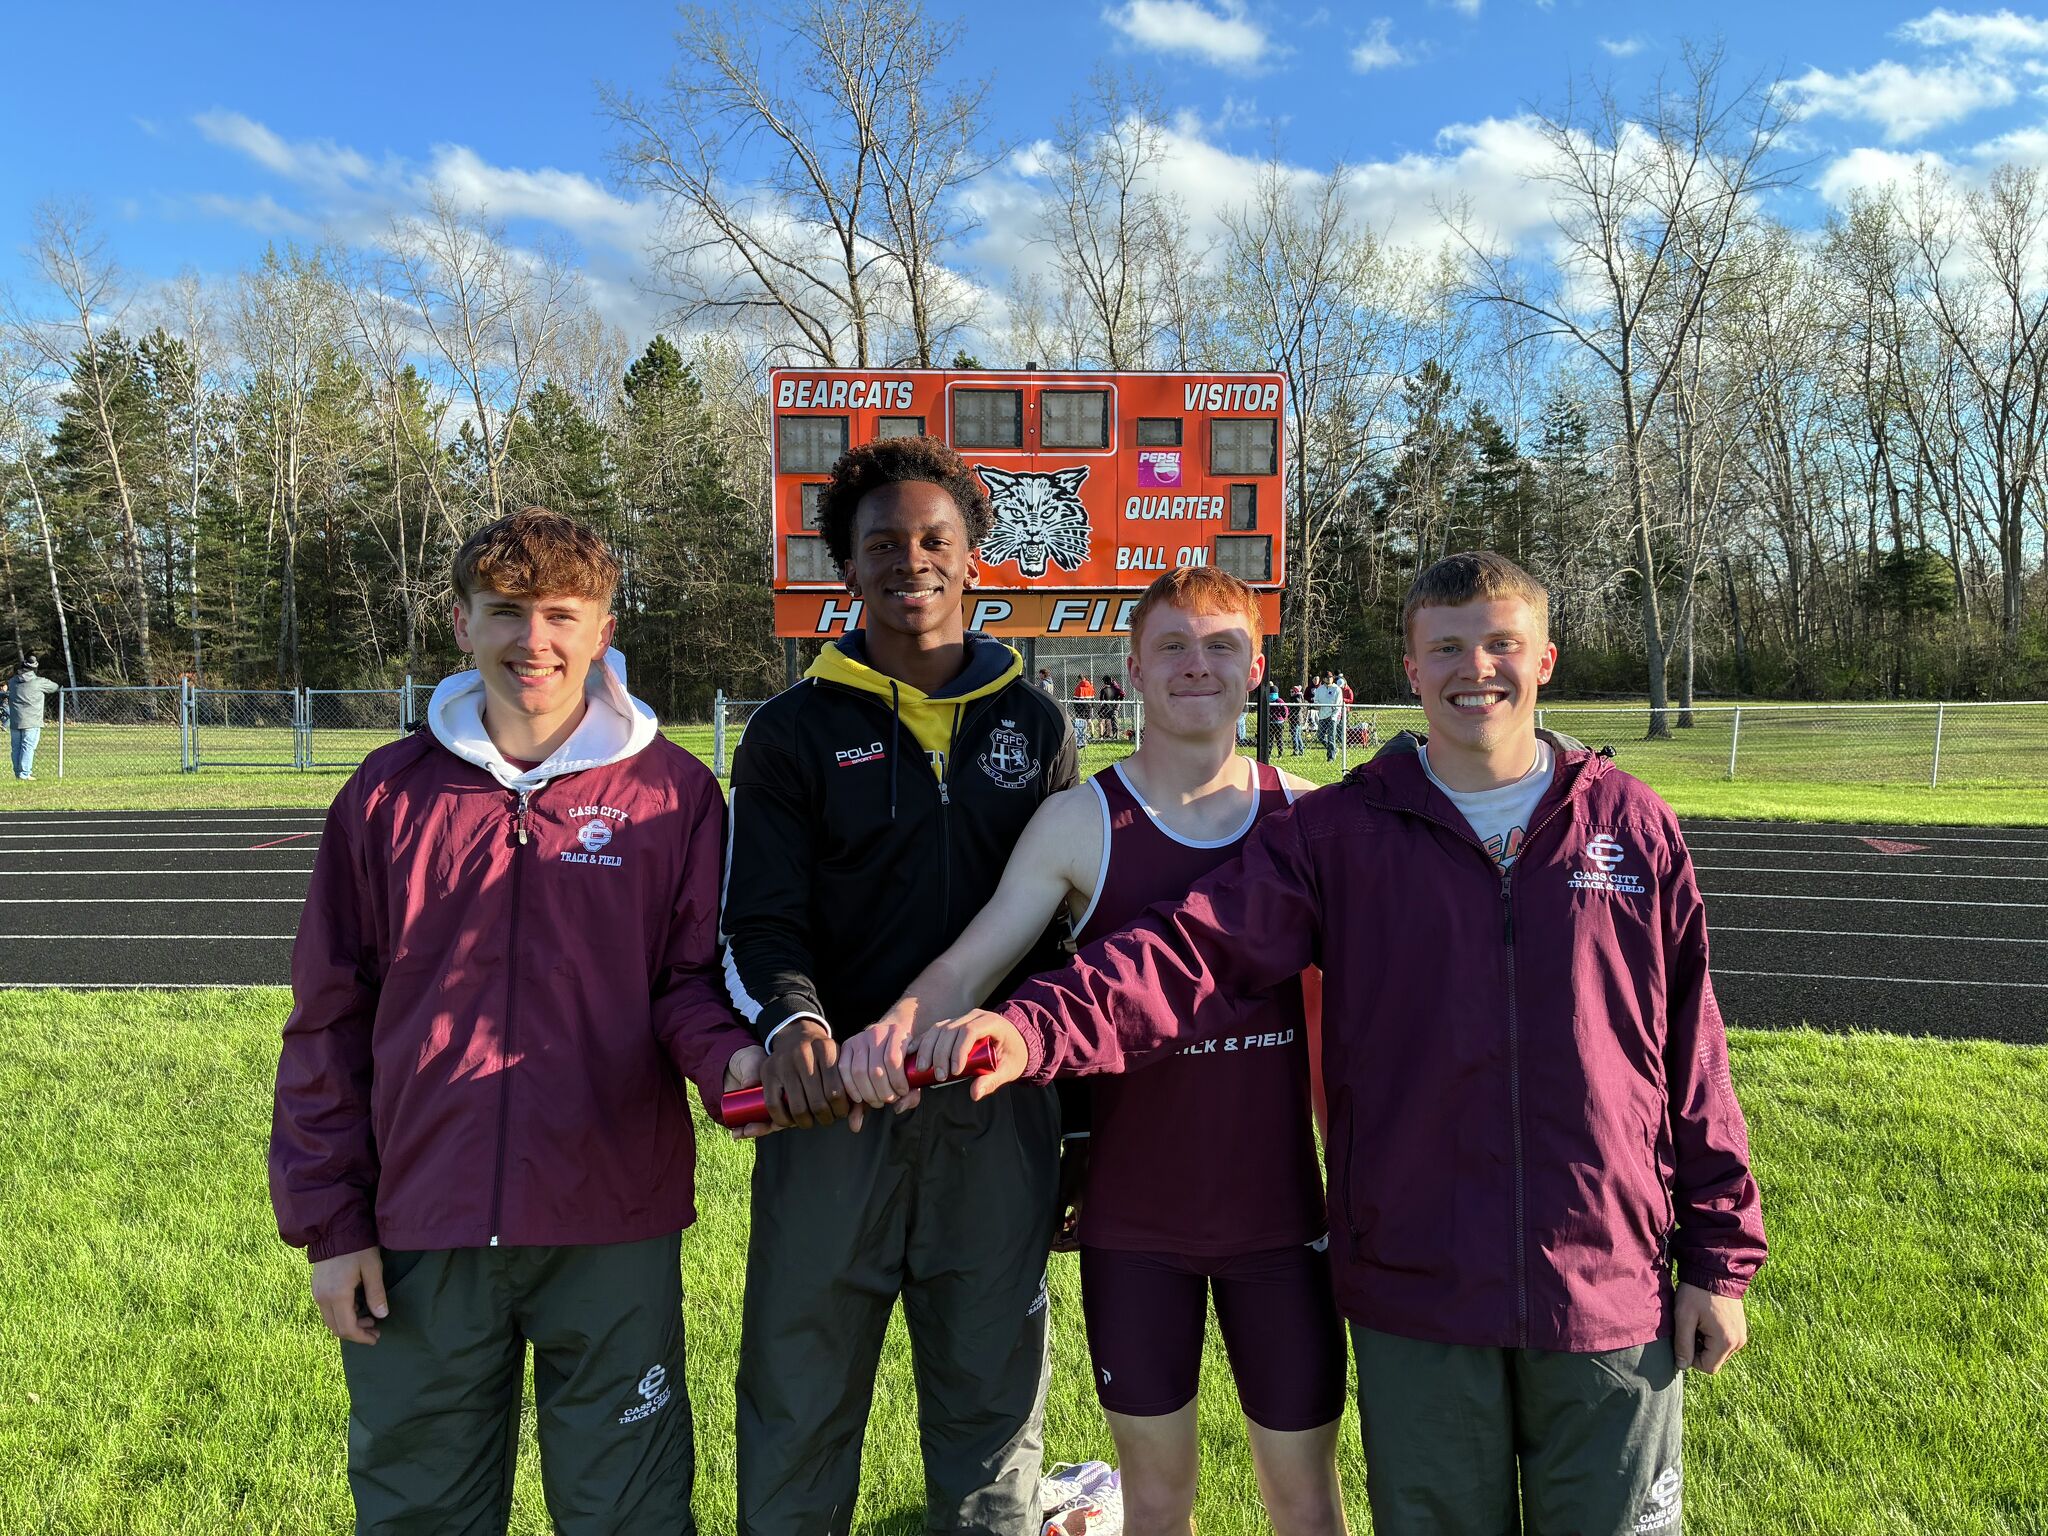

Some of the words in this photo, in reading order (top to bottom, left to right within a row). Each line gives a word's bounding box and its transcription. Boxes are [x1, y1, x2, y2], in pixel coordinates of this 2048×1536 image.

[777, 379, 914, 409] BEARCATS
[1183, 383, 1280, 412] VISITOR
[1139, 452, 1180, 463] PEPSI
[1125, 496, 1225, 520] QUARTER
[1115, 547, 1167, 570] BALL
[1175, 546, 1210, 568] ON
[815, 599, 1013, 633] HP
[1047, 599, 1140, 632] FIE
[996, 733, 1023, 746] PSFC
[836, 742, 883, 761] POLO
[568, 806, 597, 818] CASS
[600, 805, 629, 822] CITY
[560, 852, 588, 864] TRACK
[589, 855, 597, 864] &
[599, 855, 622, 867] FIELD
[1573, 871, 1607, 882] CASS
[1609, 873, 1640, 885] CITY
[1567, 880, 1605, 890] TRACK
[1605, 883, 1614, 891] &
[1615, 884, 1645, 894] FIELD
[1223, 1037, 1239, 1051] &
[1244, 1029, 1294, 1049] FIELD
[624, 1400, 652, 1416] CASS
[618, 1409, 650, 1424] TRACK
[1639, 1509, 1667, 1523] CASS
[1633, 1518, 1665, 1533] TRACK
